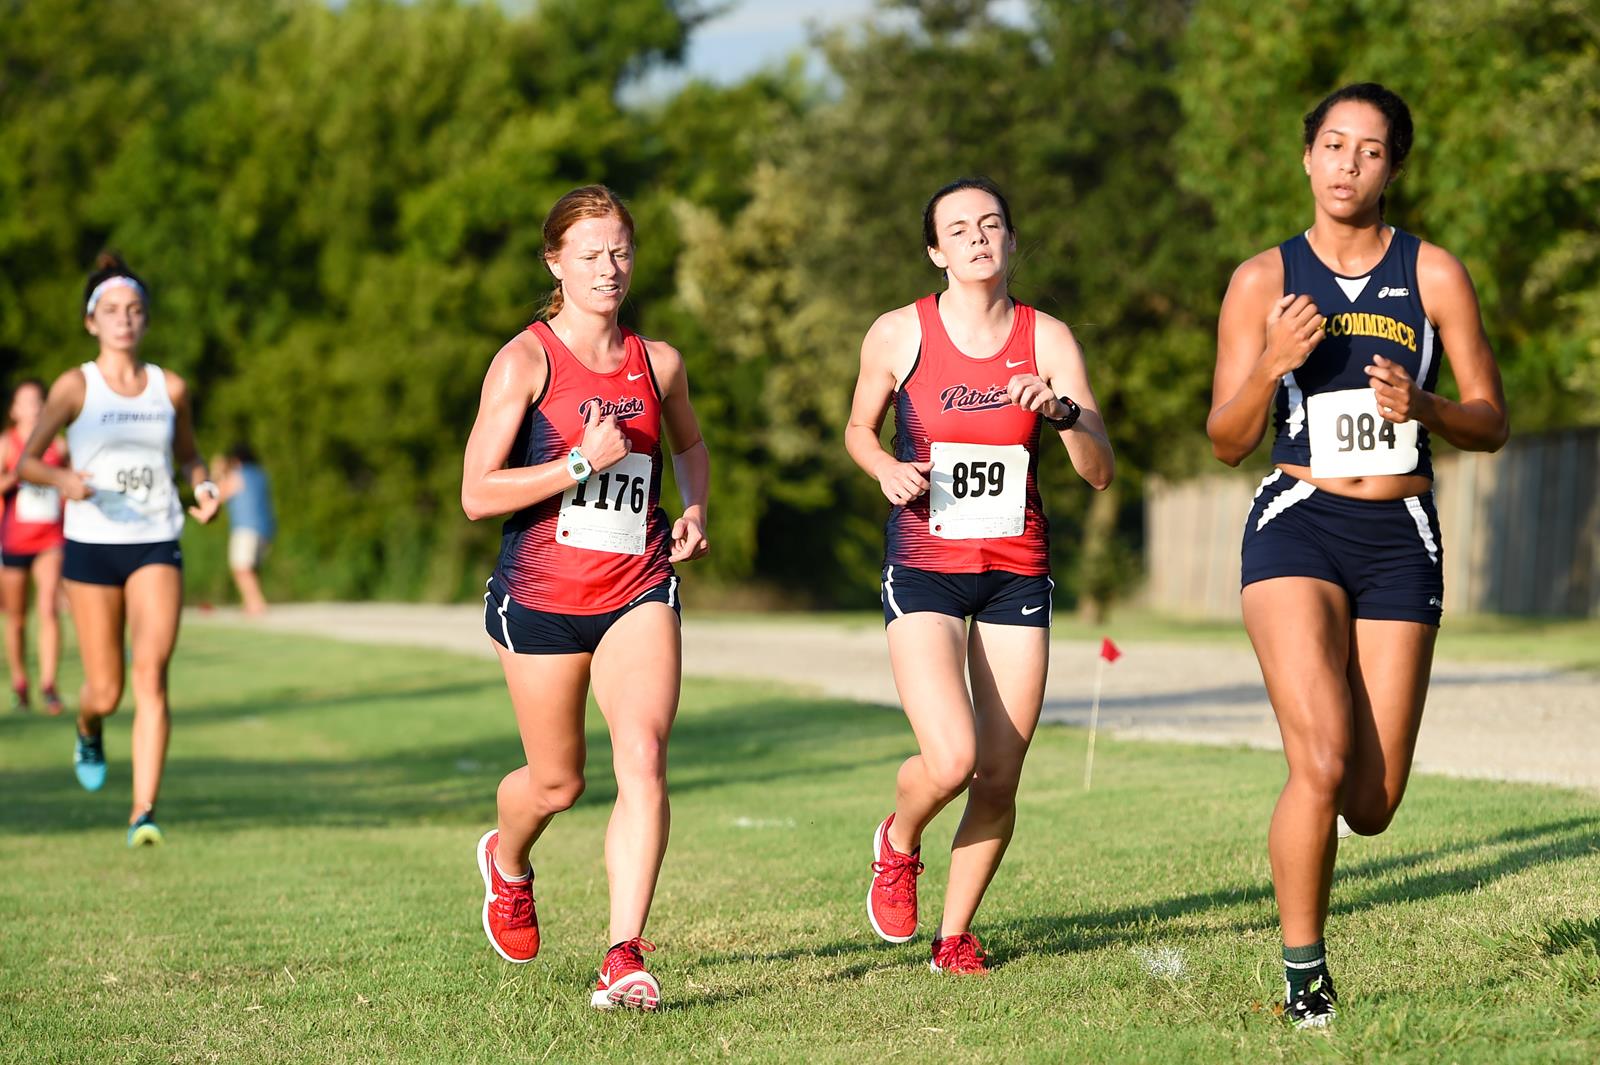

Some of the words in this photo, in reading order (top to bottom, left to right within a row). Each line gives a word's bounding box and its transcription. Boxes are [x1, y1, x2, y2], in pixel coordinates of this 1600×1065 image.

[940, 383, 1012, 414] Patrio
[1336, 413, 1396, 453] 984
[571, 472, 645, 514] 1176
[952, 461, 1006, 499] 859
